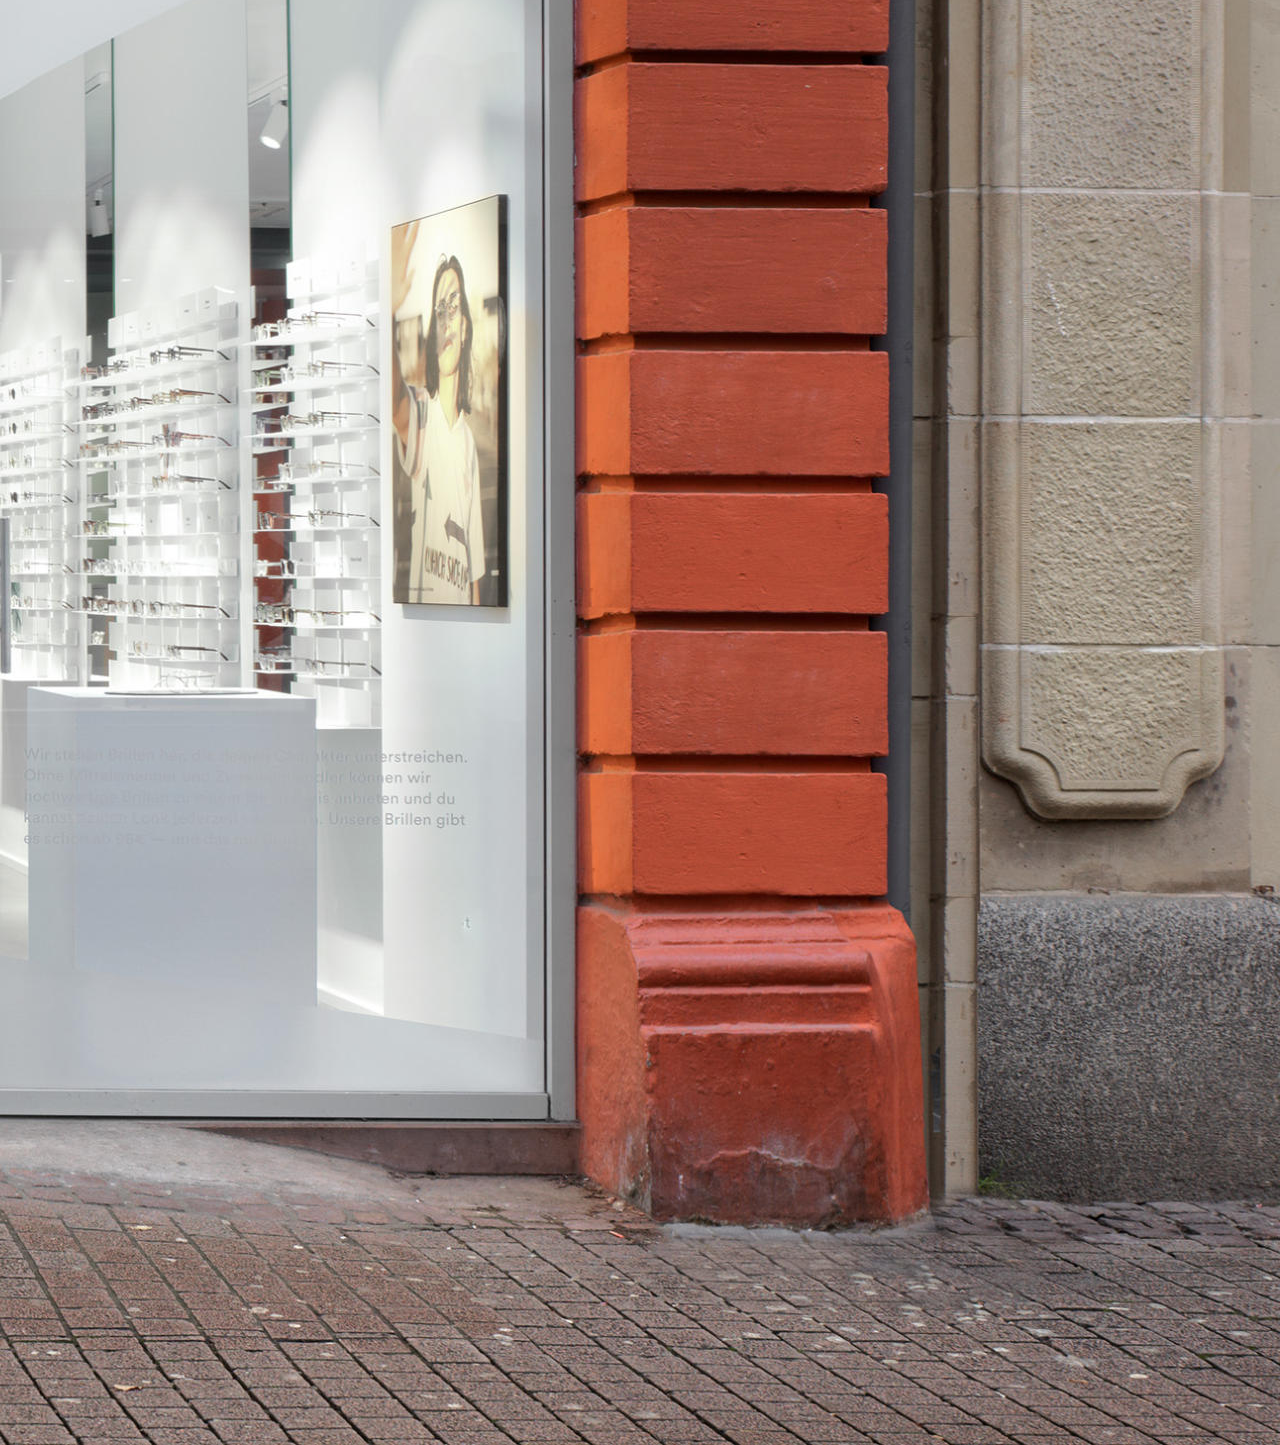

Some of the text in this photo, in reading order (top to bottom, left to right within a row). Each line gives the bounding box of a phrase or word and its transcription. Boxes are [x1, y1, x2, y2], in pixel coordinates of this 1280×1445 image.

[407, 771, 432, 784] wir
[403, 791, 432, 805] und
[436, 791, 456, 805] du
[384, 812, 432, 826] Brillen
[436, 812, 466, 829] gibt
